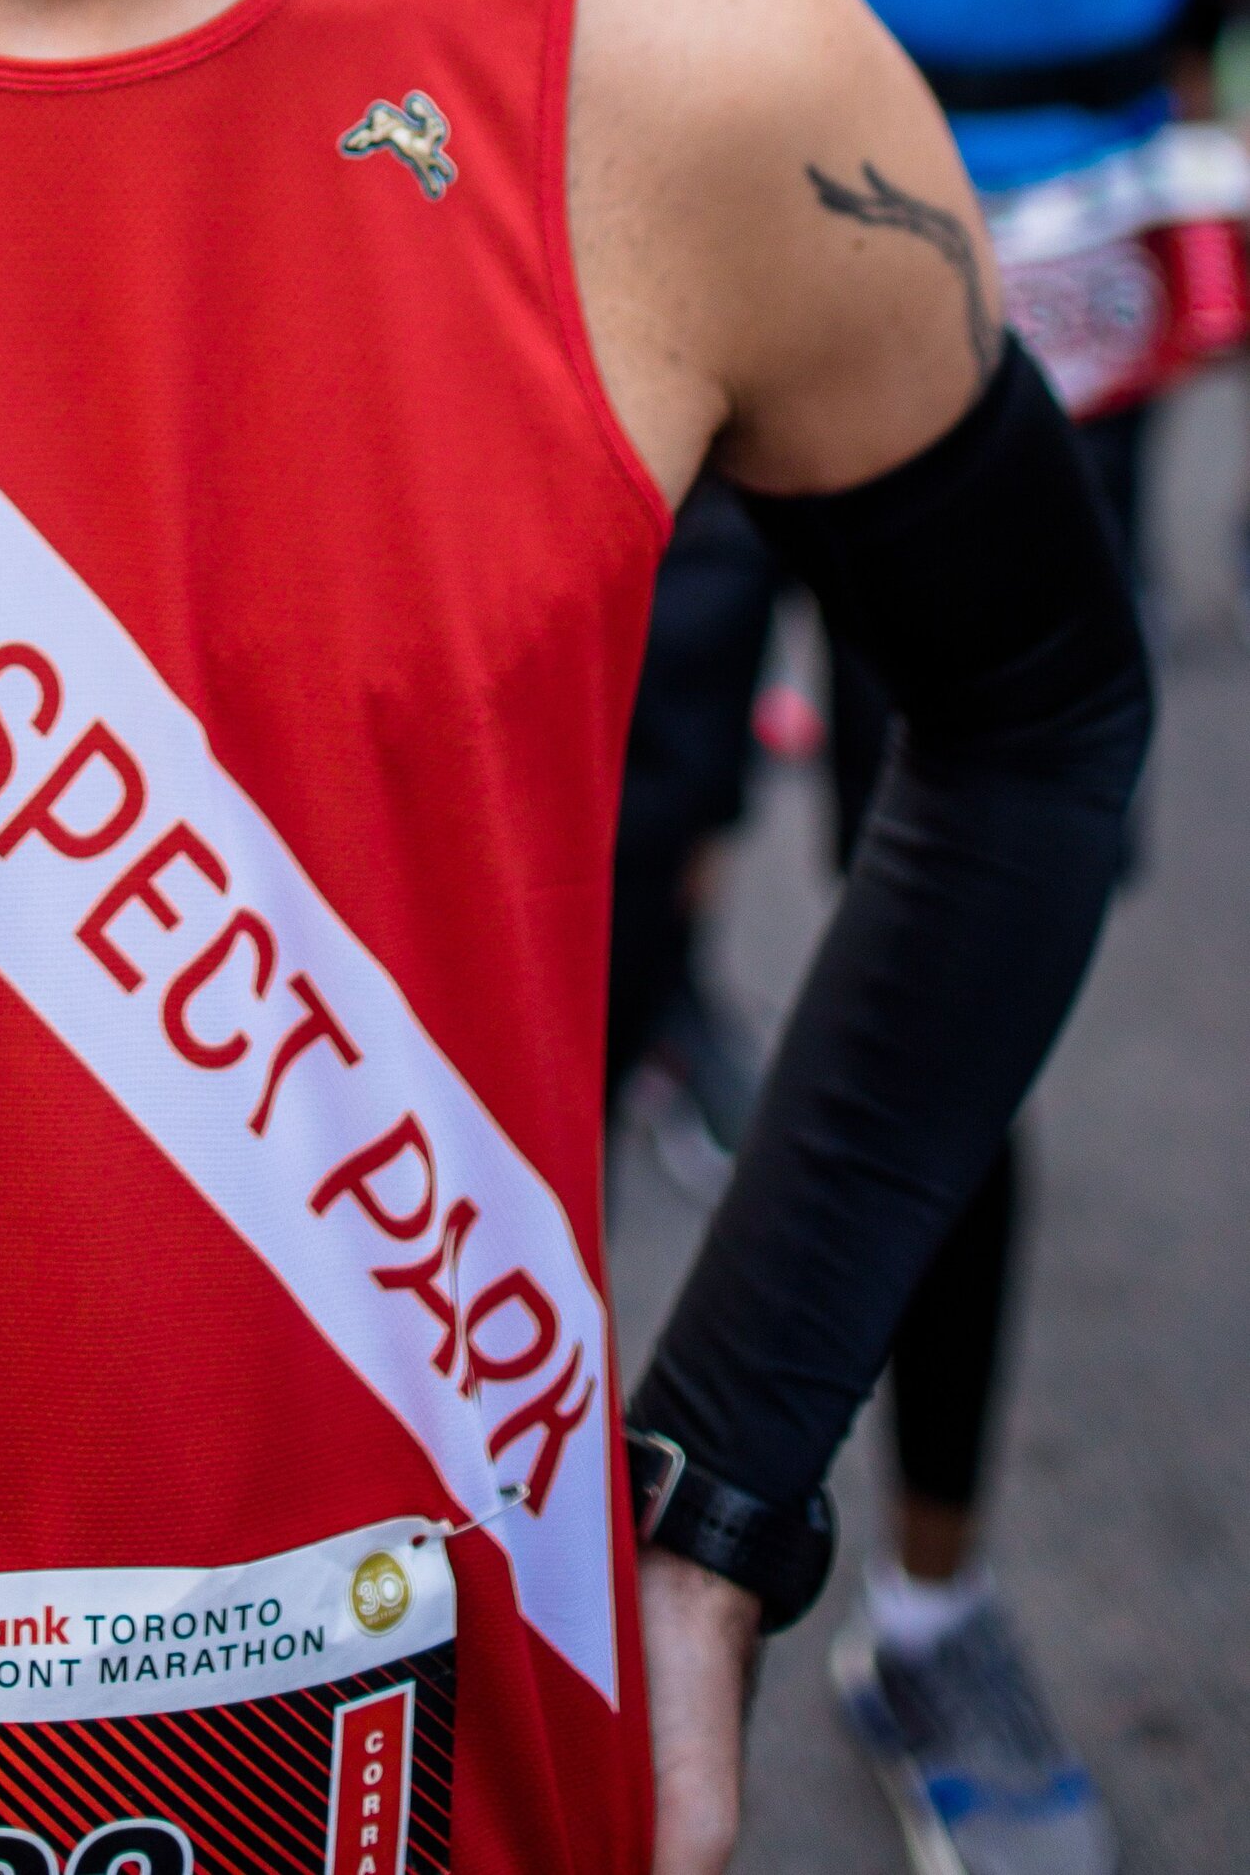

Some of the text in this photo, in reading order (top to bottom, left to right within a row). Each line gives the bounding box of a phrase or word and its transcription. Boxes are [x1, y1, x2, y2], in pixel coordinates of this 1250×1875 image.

[306, 1110, 594, 1519] PARK
[355, 1572, 406, 1616] 30
[85, 1599, 282, 1645] TORONTO
[99, 1626, 325, 1684] MARATHON
